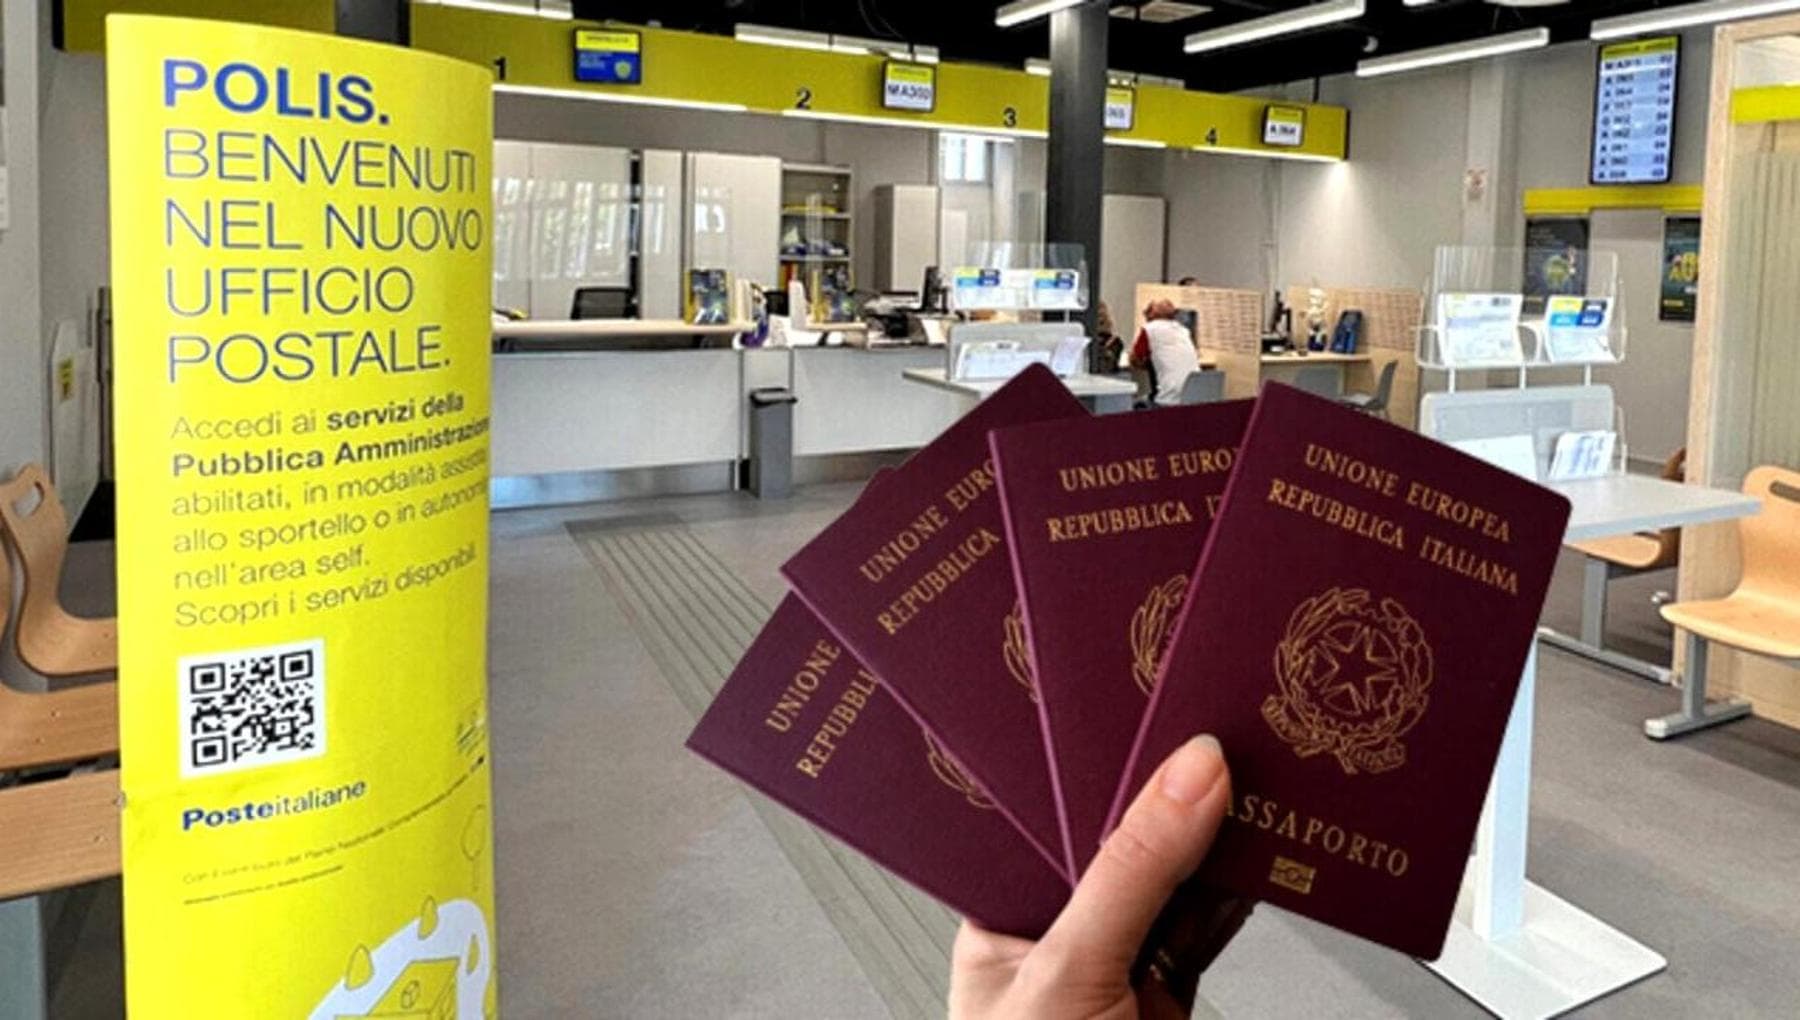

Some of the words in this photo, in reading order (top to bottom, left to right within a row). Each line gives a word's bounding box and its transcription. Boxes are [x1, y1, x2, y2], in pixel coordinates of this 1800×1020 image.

[164, 59, 389, 125] POLIS.
[493, 56, 506, 81] 1
[796, 88, 812, 110] 2
[1003, 108, 1017, 128] 3
[165, 128, 476, 193] BENVENUTI
[1205, 128, 1218, 145] 4
[165, 198, 303, 249] NEL
[325, 203, 482, 251] NUOVO
[166, 266, 415, 317] UFFICIO
[169, 325, 451, 384] POSTALE.
[171, 411, 282, 440] Accedi
[292, 412, 316, 435] ai
[327, 398, 415, 431] servizi
[421, 391, 465, 419] della
[172, 447, 324, 477] Pubblica
[1059, 458, 1159, 492] UNIONE
[1168, 448, 1240, 478] EURO
[171, 484, 292, 516] abilitati,
[303, 482, 328, 505] in
[336, 463, 436, 498] modalità
[1304, 444, 1399, 497] UNIONE
[1405, 481, 1512, 543] EUROPEA
[173, 529, 228, 553] allo
[238, 511, 368, 551] sportello
[374, 509, 390, 528] o
[396, 501, 416, 524] in
[860, 504, 949, 585] UNIONE
[1047, 501, 1193, 543] REPUBBLICA
[1268, 479, 1405, 550] REPUBBLICA
[1420, 536, 1519, 596] ITALIANA
[174, 557, 306, 591] nell'area
[317, 544, 370, 575] self.
[877, 526, 1001, 636] REPUBBLICA
[174, 595, 278, 627] Scopri
[288, 592, 295, 614] i
[306, 575, 389, 614] servizi
[765, 638, 842, 735] UNIONE
[181, 780, 367, 831] Posteitaliane
[1228, 794, 1409, 877] SSAPORTO
